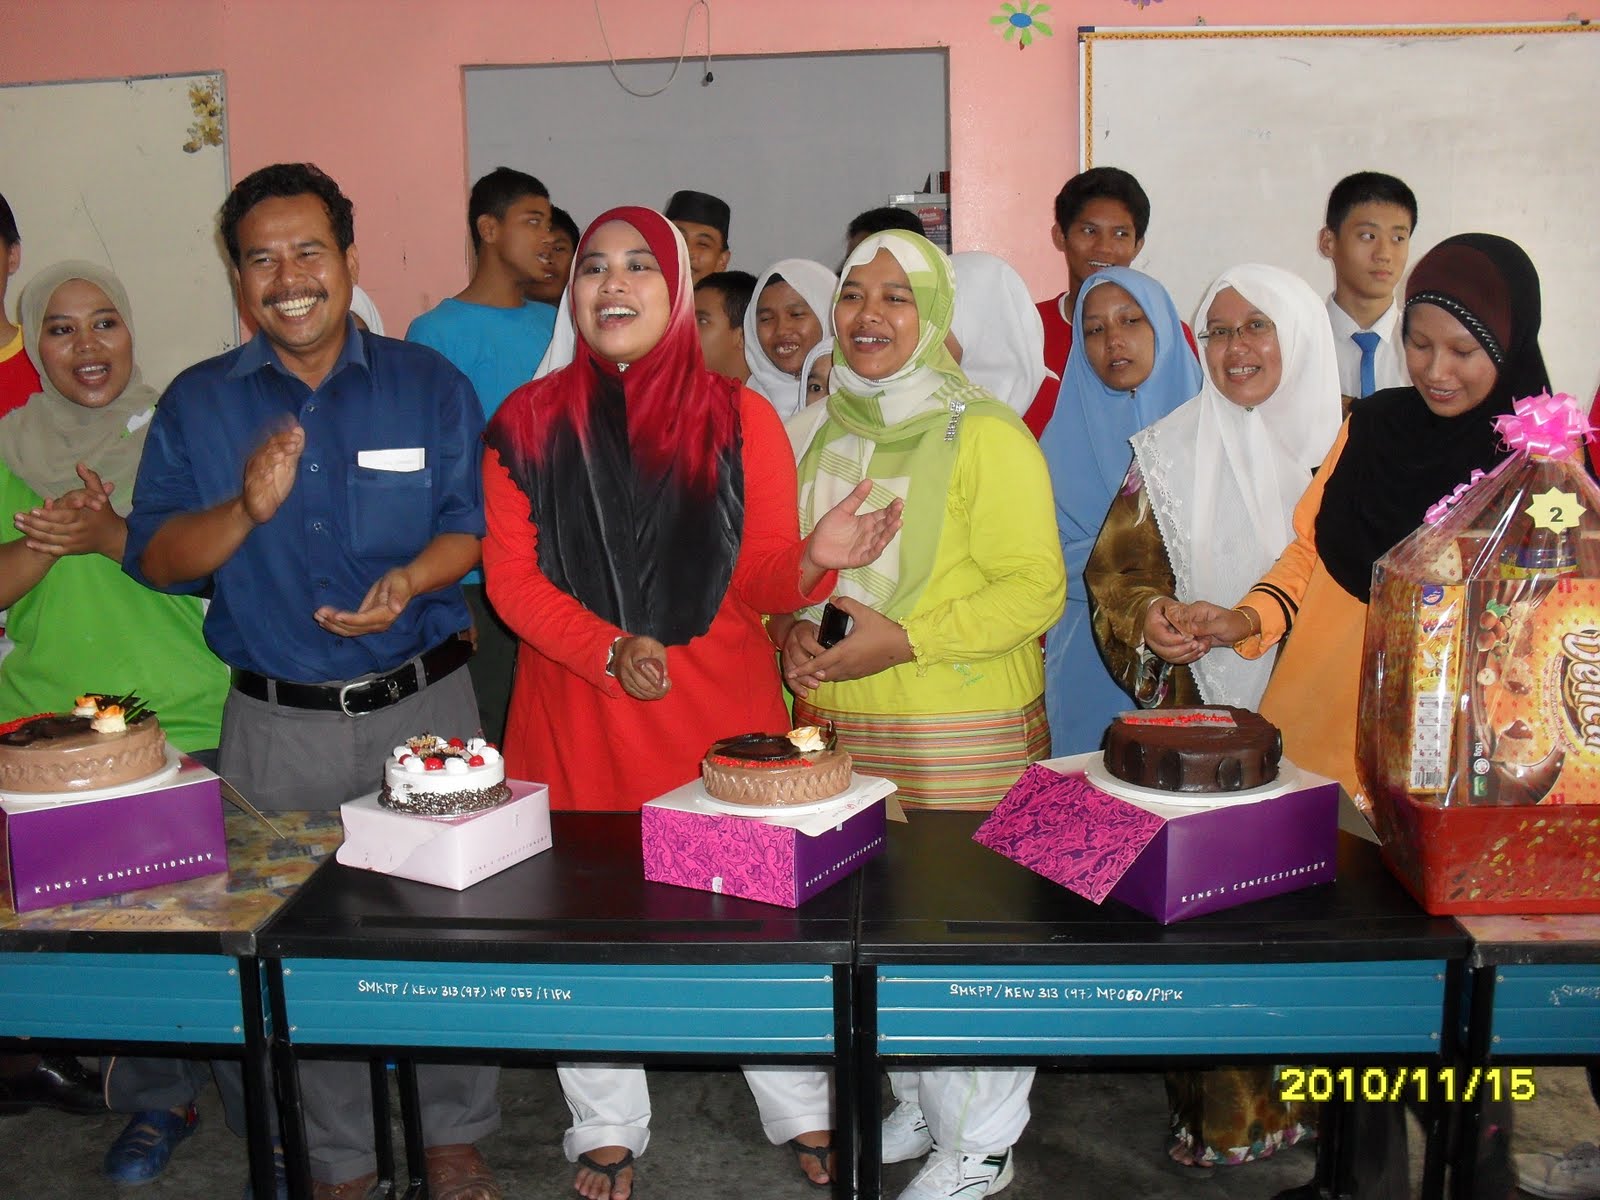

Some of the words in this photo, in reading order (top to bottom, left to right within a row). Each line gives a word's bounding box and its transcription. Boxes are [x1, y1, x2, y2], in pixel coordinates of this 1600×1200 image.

[1549, 506, 1564, 523] 2
[34, 878, 88, 894] KING'S
[98, 853, 213, 883] CONFECTIONERY
[1181, 886, 1225, 903] KING'S
[1233, 861, 1326, 891] CONFECTIONERY
